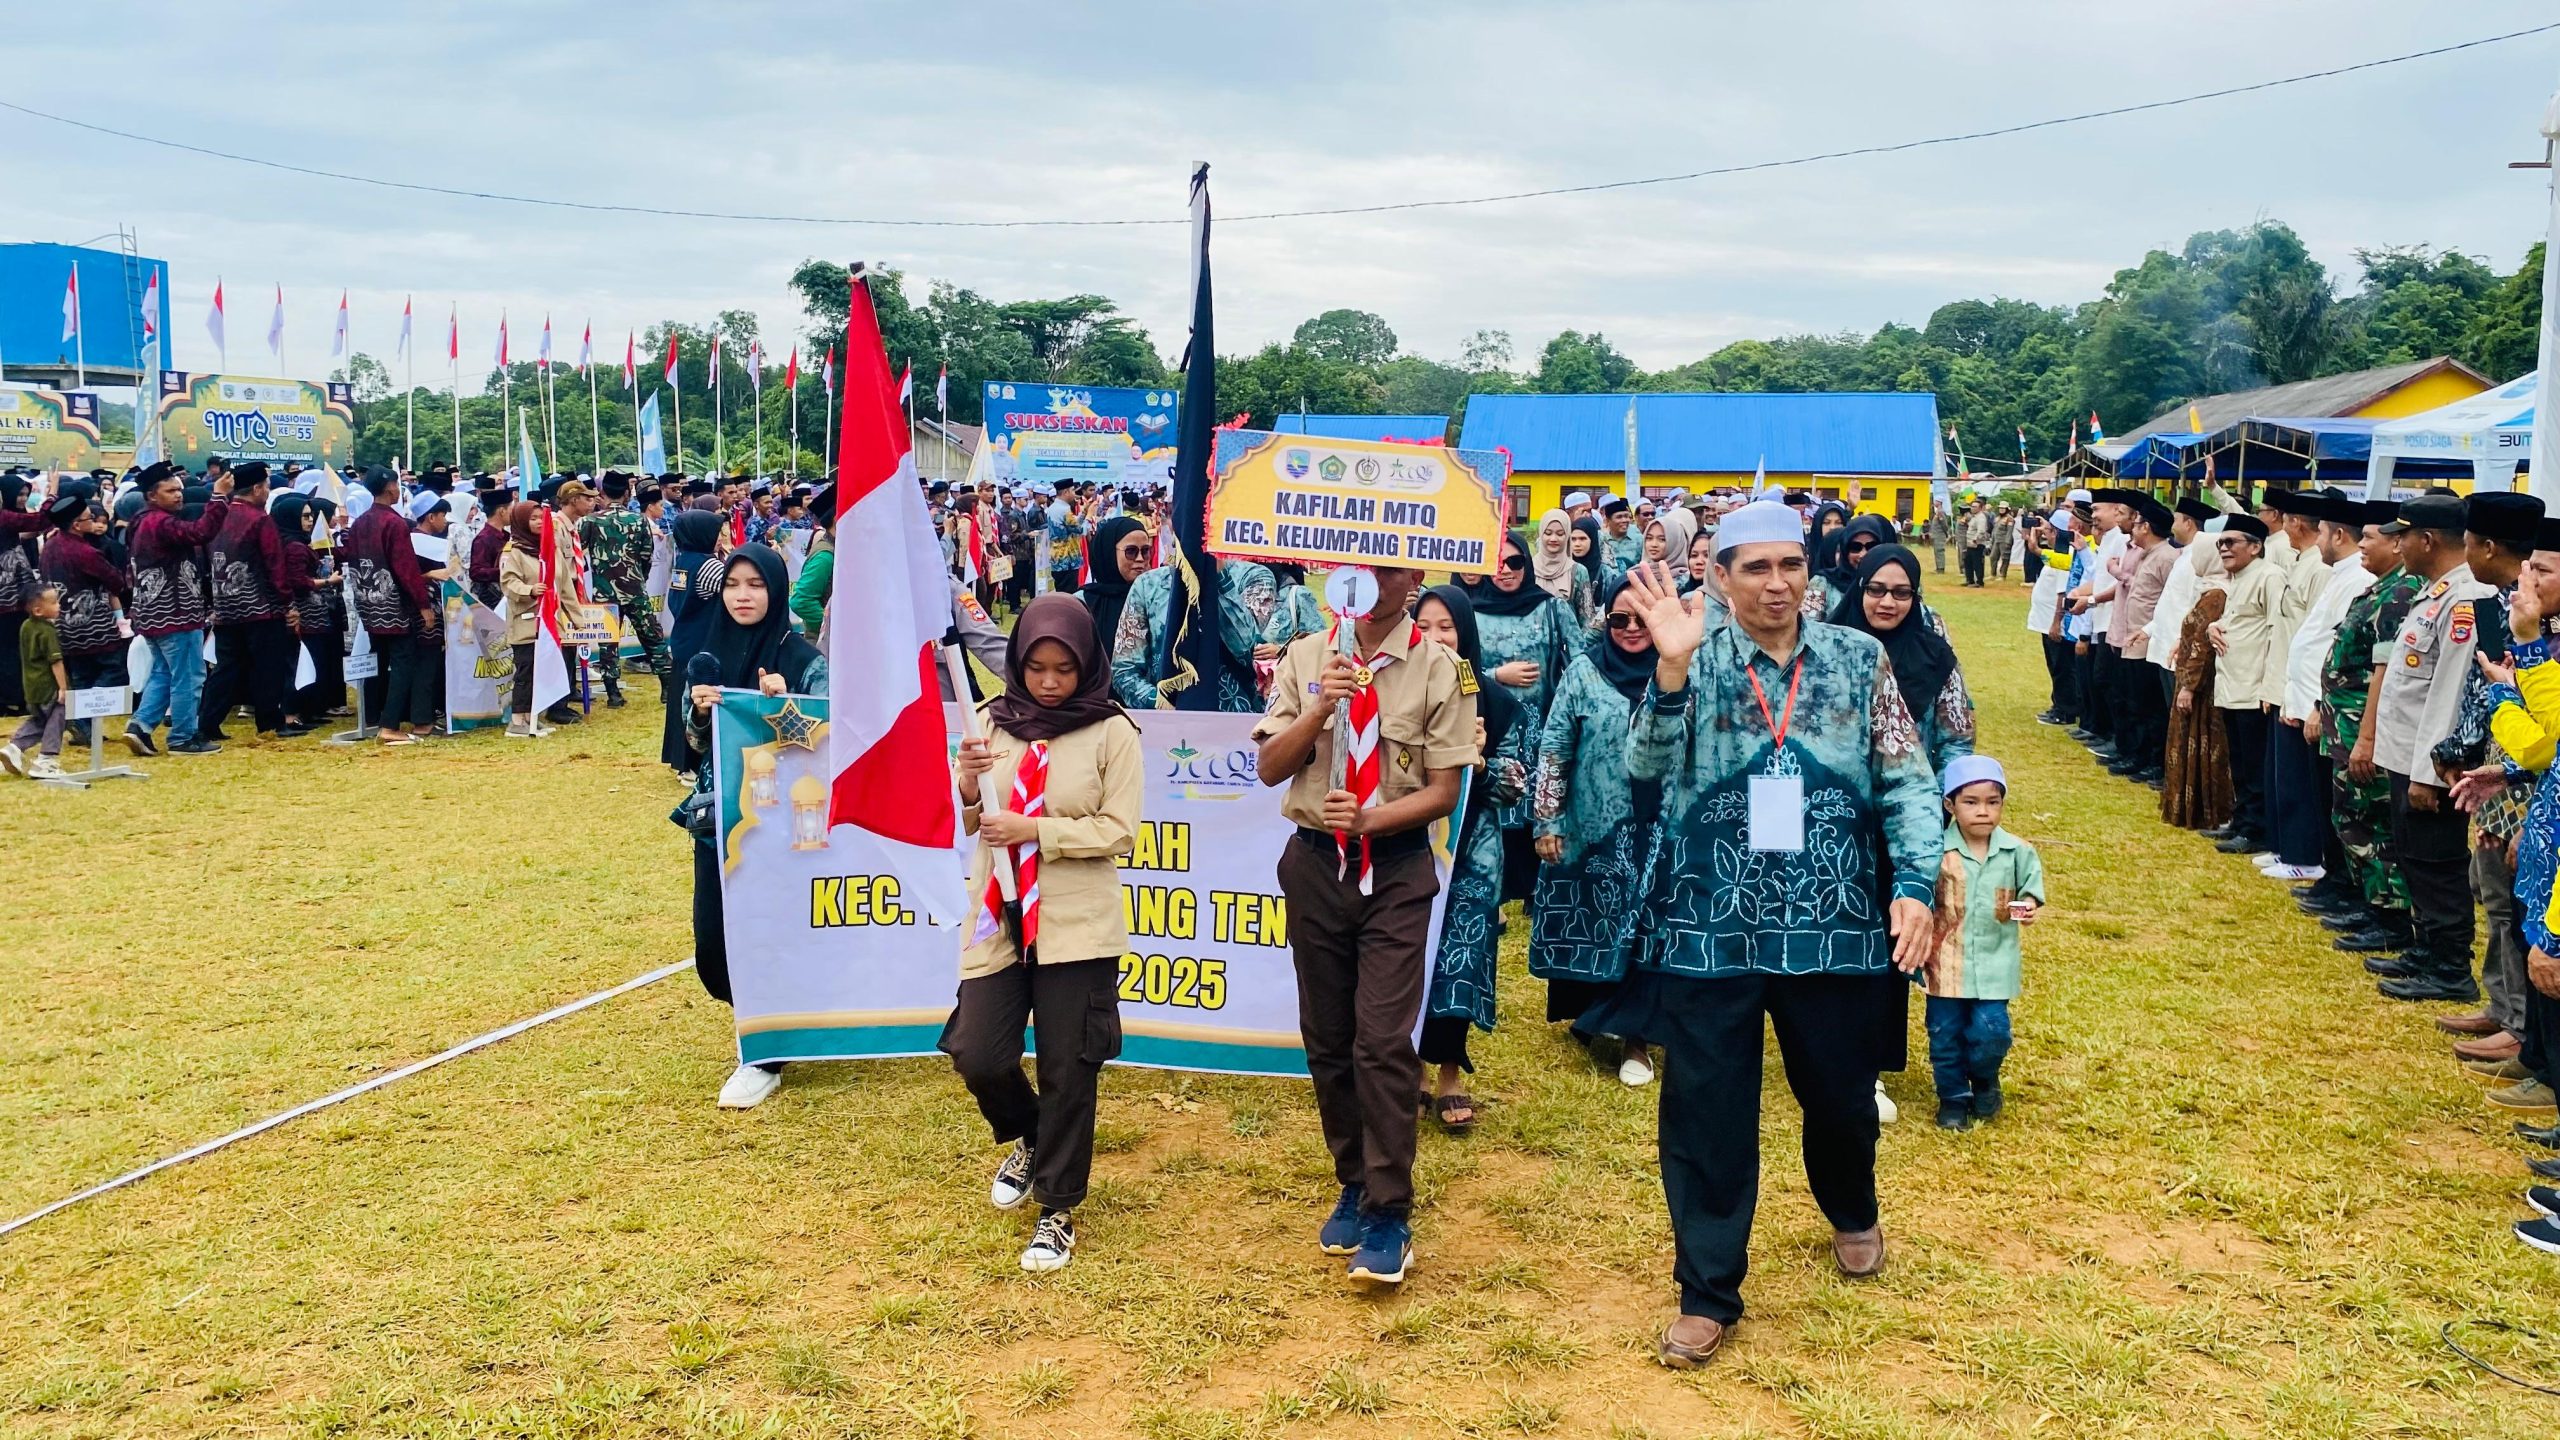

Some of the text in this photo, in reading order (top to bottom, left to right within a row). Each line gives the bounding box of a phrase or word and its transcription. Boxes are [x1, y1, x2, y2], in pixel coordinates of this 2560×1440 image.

[203, 407, 276, 448] MTQ
[272, 414, 316, 424] NASIONAL
[1004, 413, 1128, 433] SUKSESKAN
[212, 450, 313, 461] TINGKAT KABUPATEN KOTABARU
[2430, 435, 2452, 447] SIAGA
[1275, 491, 1436, 529] KAFILAH MTQ
[1224, 519, 1484, 564] KEC. KELUMPANG TENGAH
[1343, 576, 1358, 608] 1
[580, 646, 589, 657] 15
[810, 874, 916, 929] KEC.
[1210, 890, 1289, 949] TEN
[1118, 952, 1227, 1011] 2025
